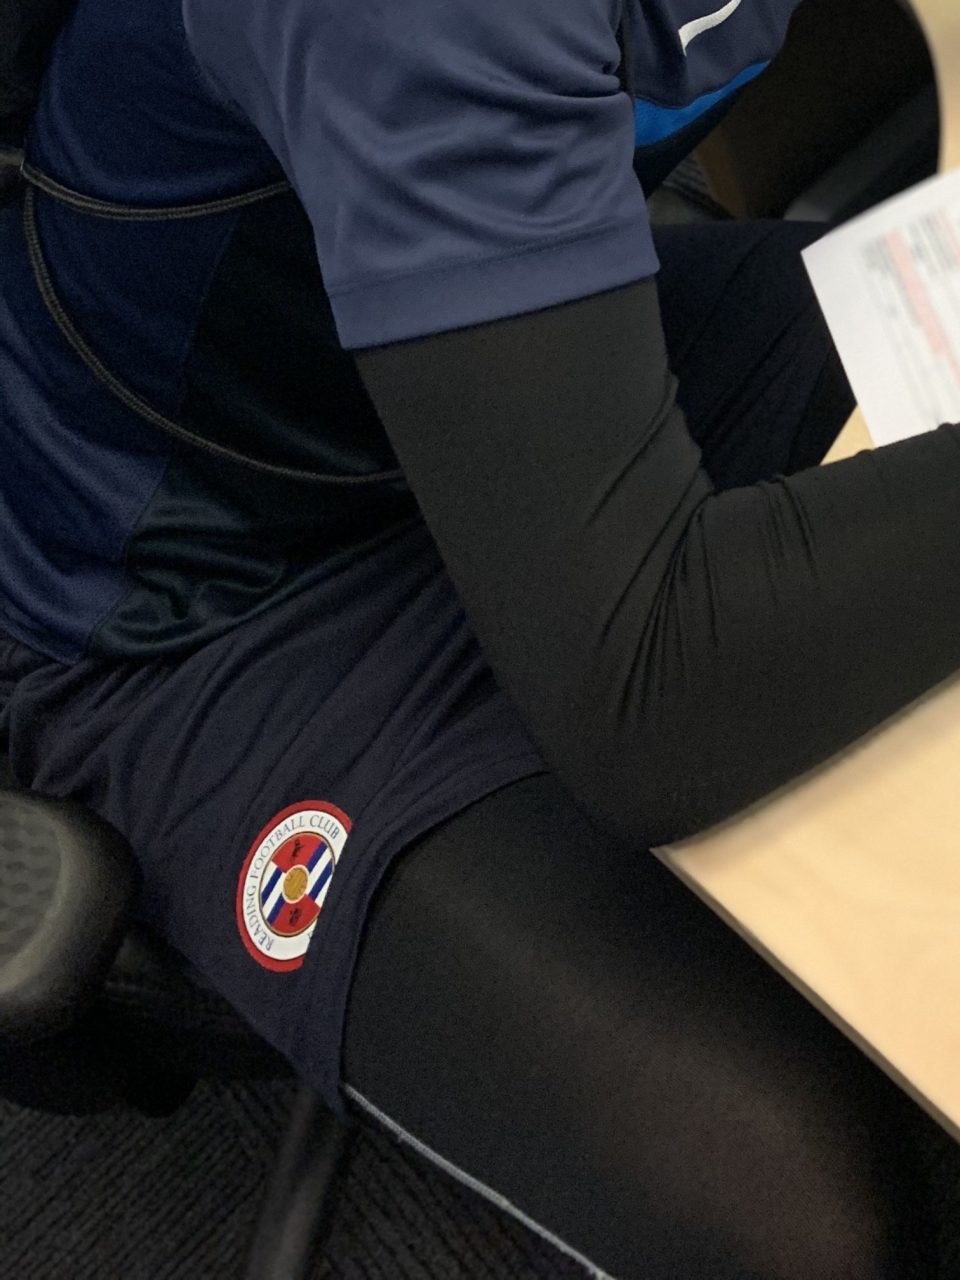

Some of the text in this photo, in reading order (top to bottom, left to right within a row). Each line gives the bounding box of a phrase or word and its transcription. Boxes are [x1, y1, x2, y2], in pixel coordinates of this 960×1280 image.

[246, 814, 340, 951] READING FOOTBALL CLUB
